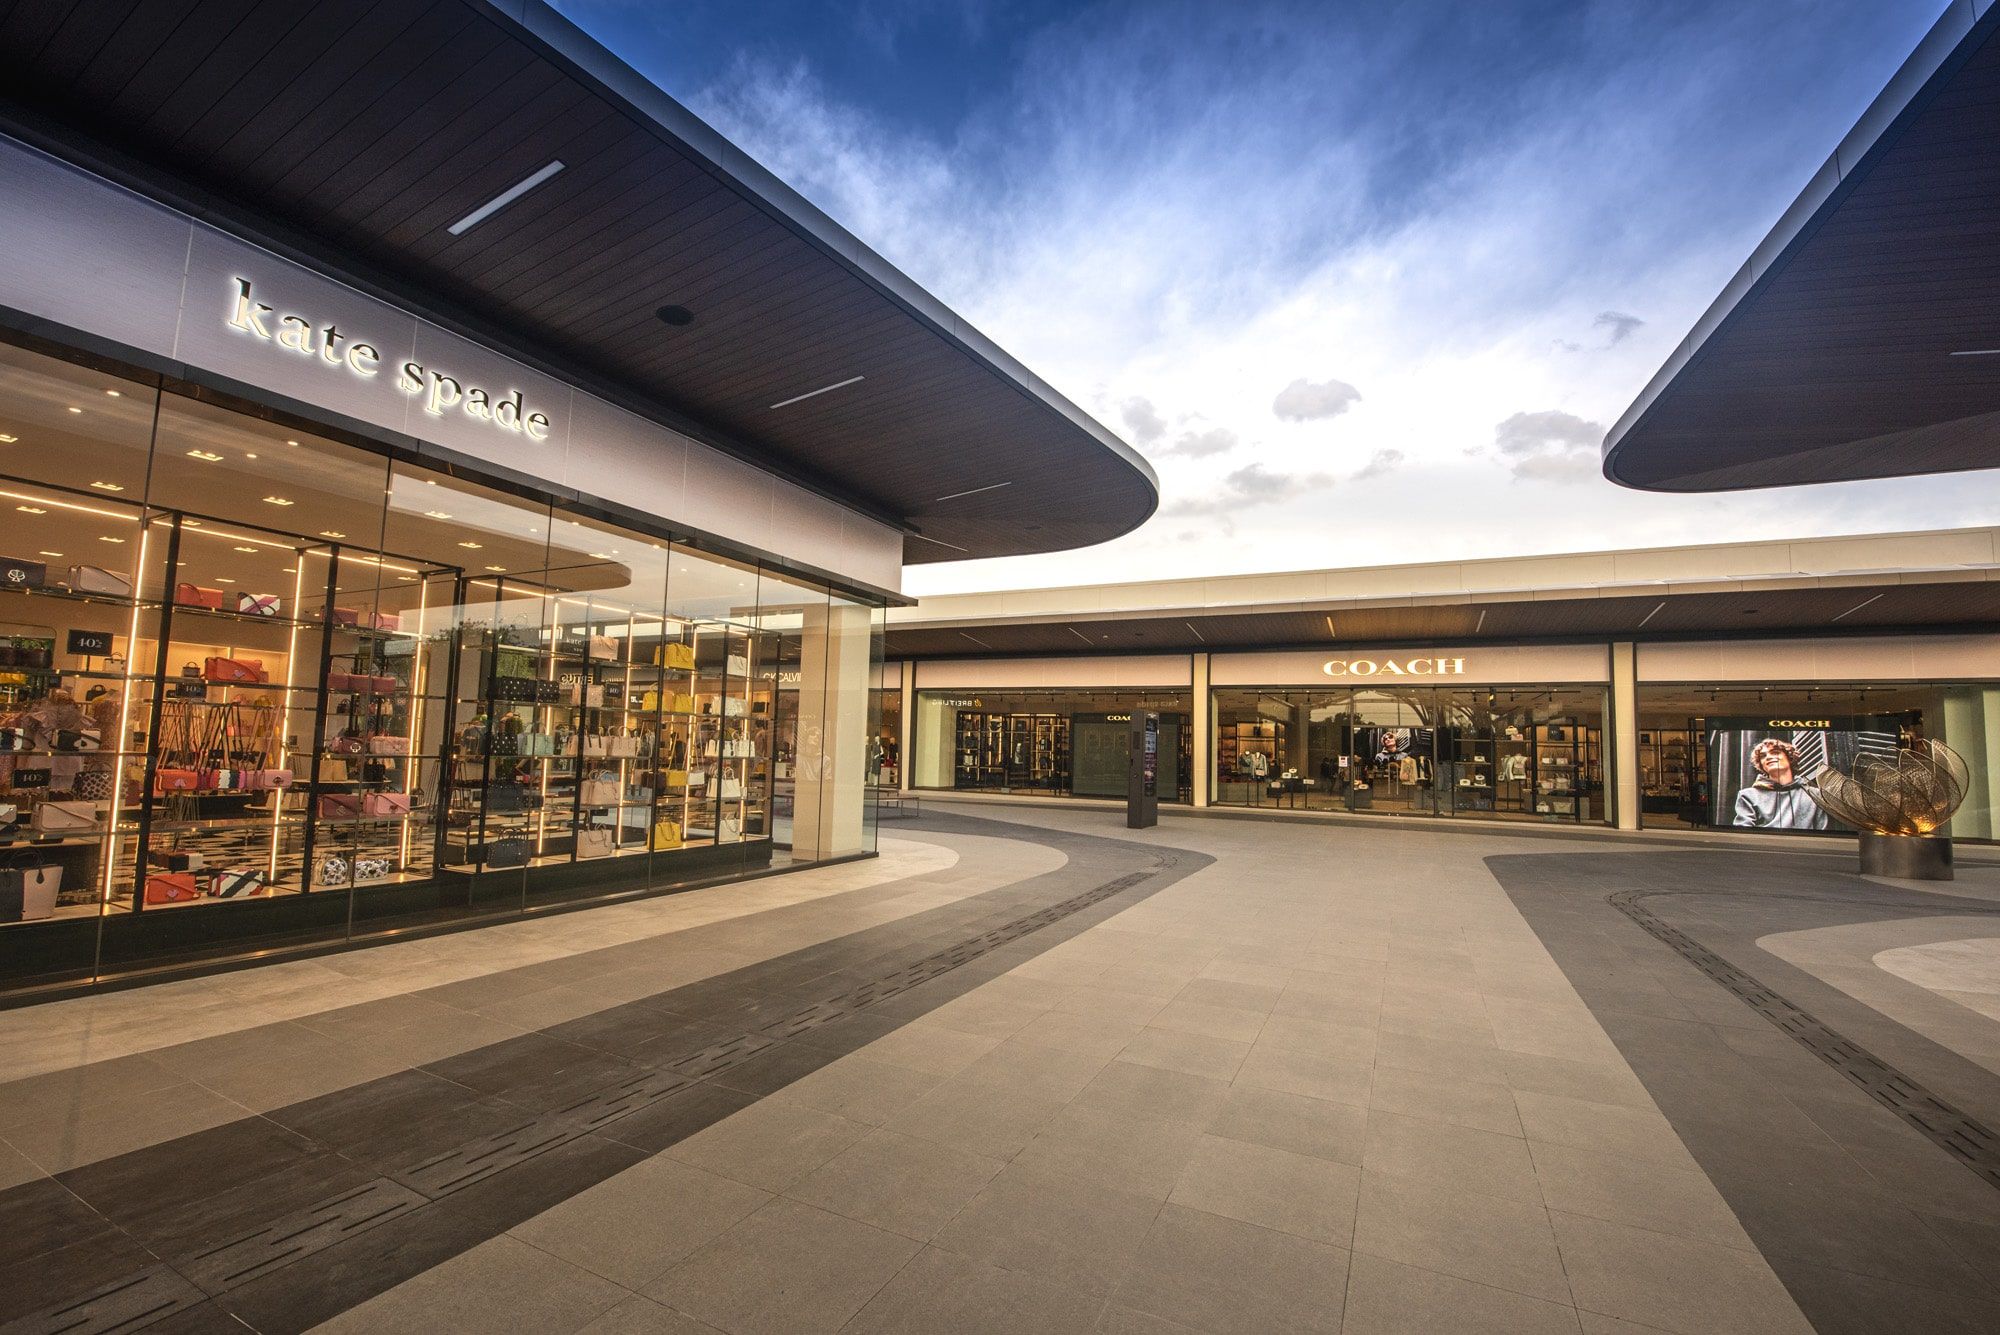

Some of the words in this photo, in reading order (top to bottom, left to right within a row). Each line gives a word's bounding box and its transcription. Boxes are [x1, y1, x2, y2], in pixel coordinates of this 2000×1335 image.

[228, 277, 380, 376] kate
[400, 360, 551, 440] spade
[1323, 657, 1466, 676] COACH
[1768, 719, 1831, 728] COACH
